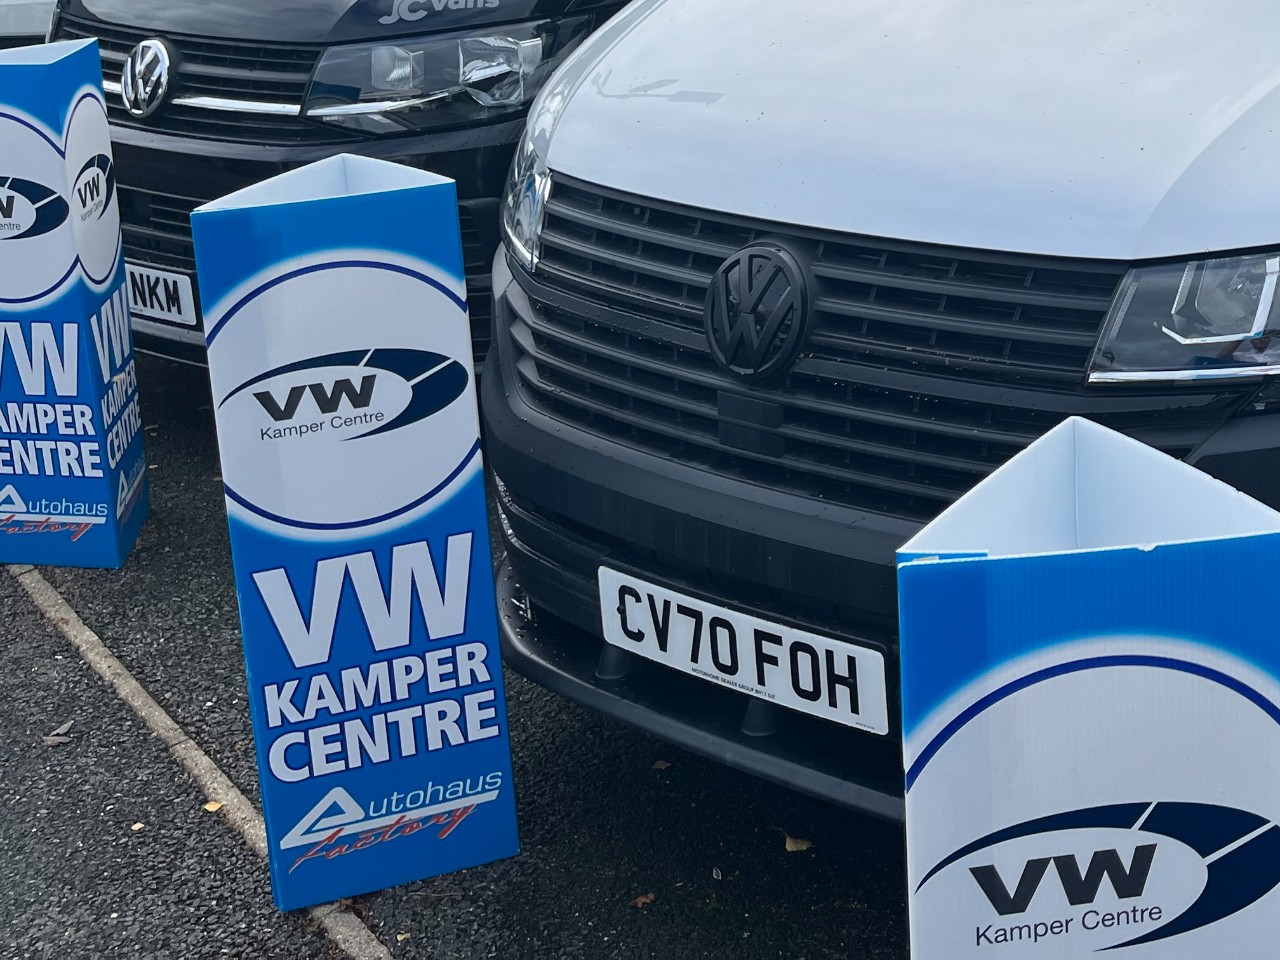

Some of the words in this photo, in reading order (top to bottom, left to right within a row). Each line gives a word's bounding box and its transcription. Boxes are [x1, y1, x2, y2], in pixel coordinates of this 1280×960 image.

[0, 222, 21, 230] entre
[77, 173, 100, 209] VW
[130, 271, 183, 315] NKM
[0, 322, 78, 396] W
[90, 281, 131, 385] VW
[0, 403, 96, 436] MPER
[101, 359, 137, 430] KAMPER
[252, 374, 377, 421] VW
[260, 417, 326, 442] Kamper
[331, 410, 385, 431] Centre
[0, 439, 104, 478] ENTRE
[107, 392, 142, 470] CENTRE
[252, 532, 473, 668] VW
[264, 642, 490, 727] KAMPER
[617, 584, 739, 676] CV70
[754, 630, 862, 715] FOH
[268, 690, 499, 782] CENTRE
[280, 771, 502, 850] Autohaus
[968, 843, 1157, 916] VW
[975, 919, 1074, 947] Kamper
[1081, 904, 1163, 931] Centre
